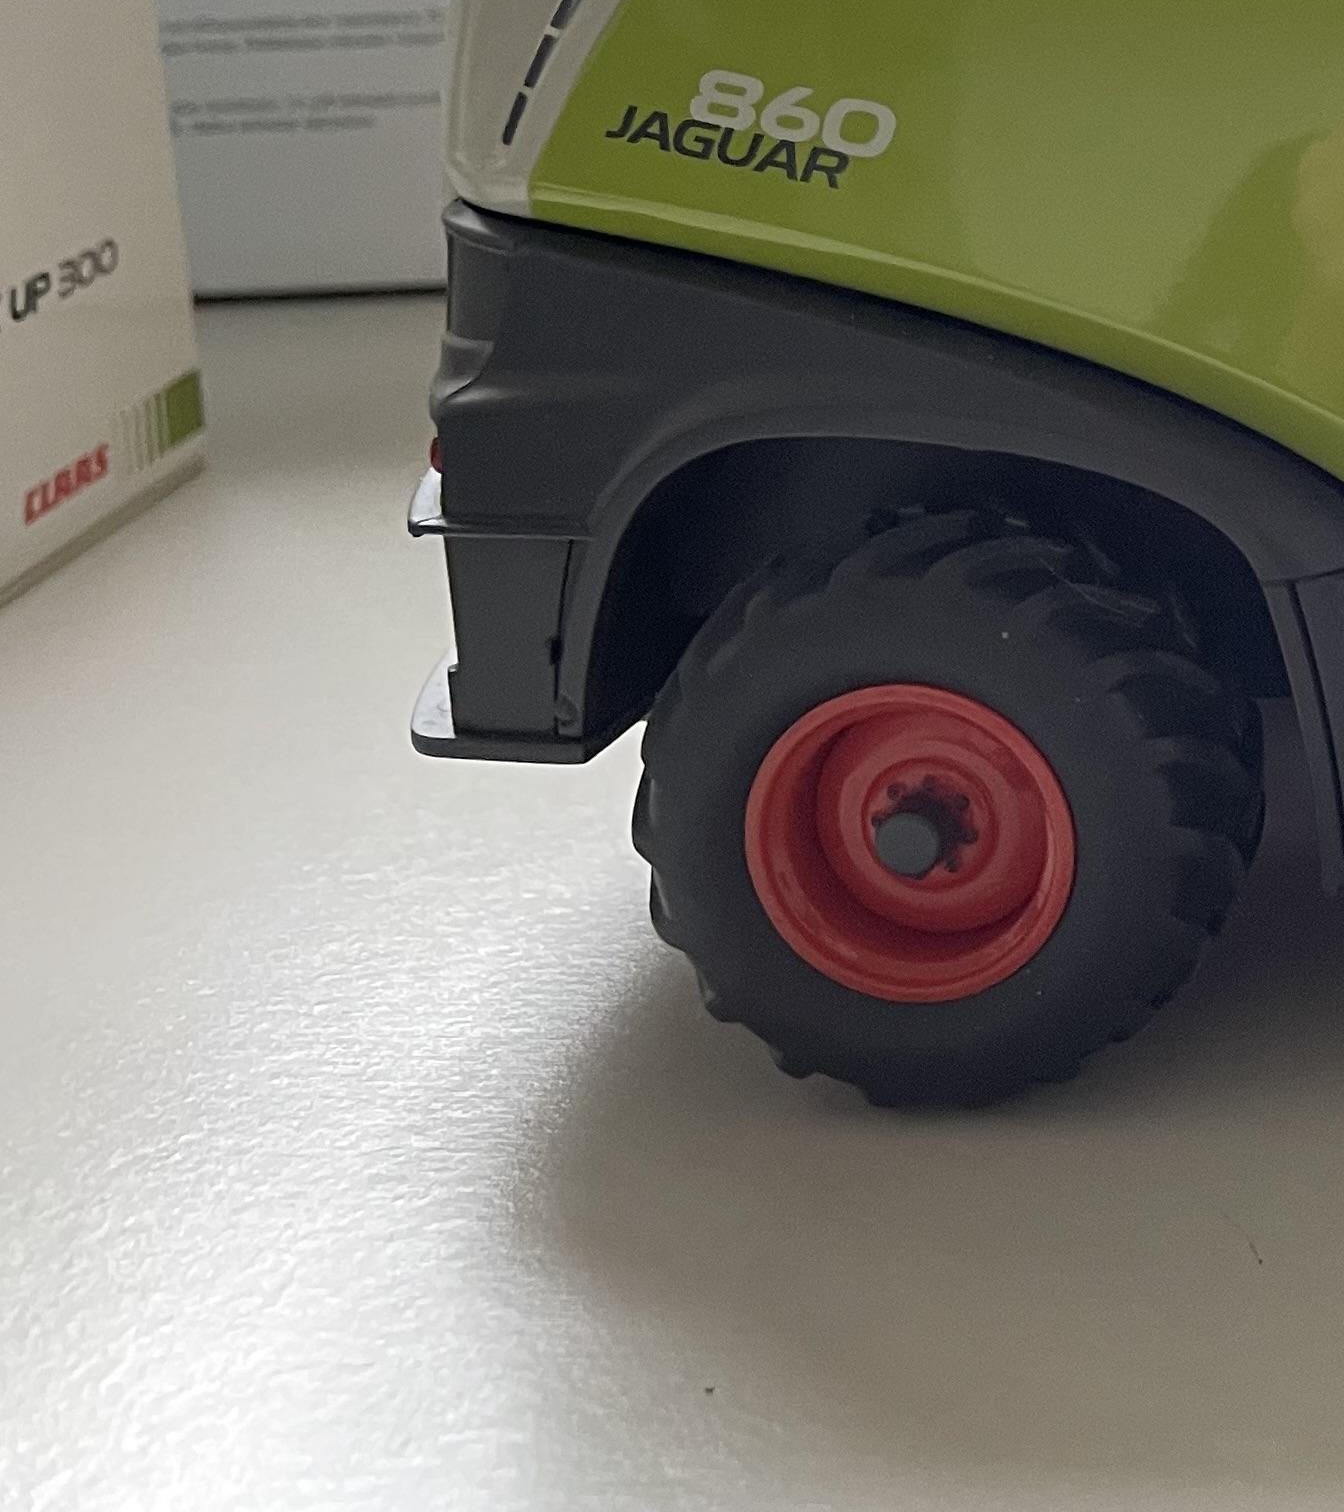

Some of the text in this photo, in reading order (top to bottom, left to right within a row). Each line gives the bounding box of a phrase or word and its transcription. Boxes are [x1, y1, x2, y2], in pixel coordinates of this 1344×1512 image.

[605, 105, 850, 189] JAGUAR
[690, 69, 897, 158] 860
[11, 239, 119, 322] UP 300
